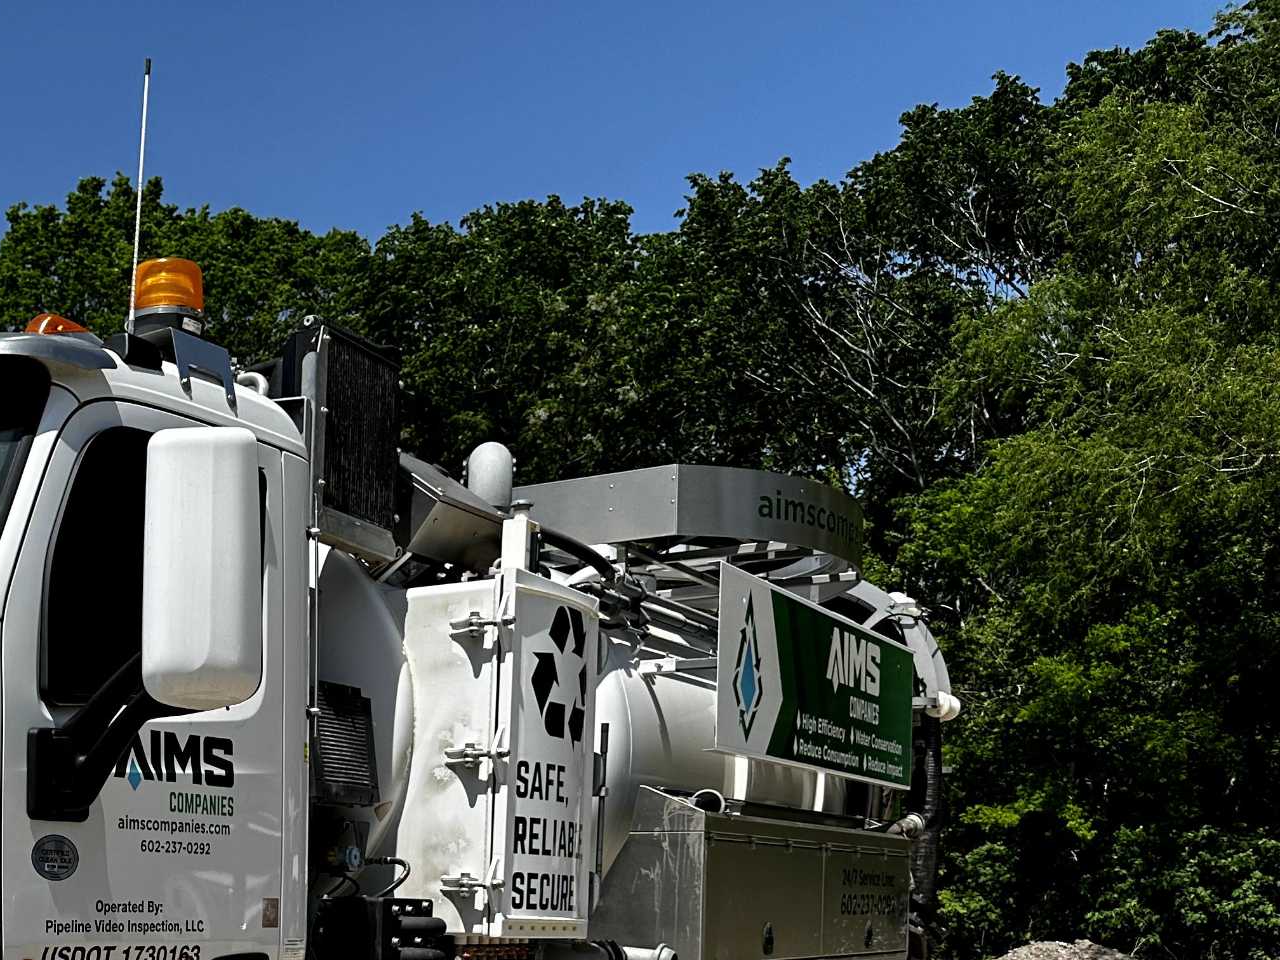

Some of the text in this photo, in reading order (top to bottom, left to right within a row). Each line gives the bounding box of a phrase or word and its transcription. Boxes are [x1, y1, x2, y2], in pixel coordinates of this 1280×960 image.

[826, 627, 880, 697] AIMS
[850, 696, 879, 725] COMPANIES
[802, 713, 846, 743] High Efficiency
[799, 738, 859, 768] Reduce Consumption
[855, 729, 902, 756] Water Conservation
[113, 729, 235, 791] AIMS
[868, 755, 886, 774] Reduce
[515, 760, 568, 808] SAFE,
[169, 791, 234, 817] COMPANIES
[118, 815, 231, 835] aimscompanies.com
[141, 839, 211, 855] 602-237-0292
[511, 871, 575, 912] SECURE
[95, 900, 163, 916] Operated By:
[45, 919, 205, 936] Pipeline Video Inspection, LLC
